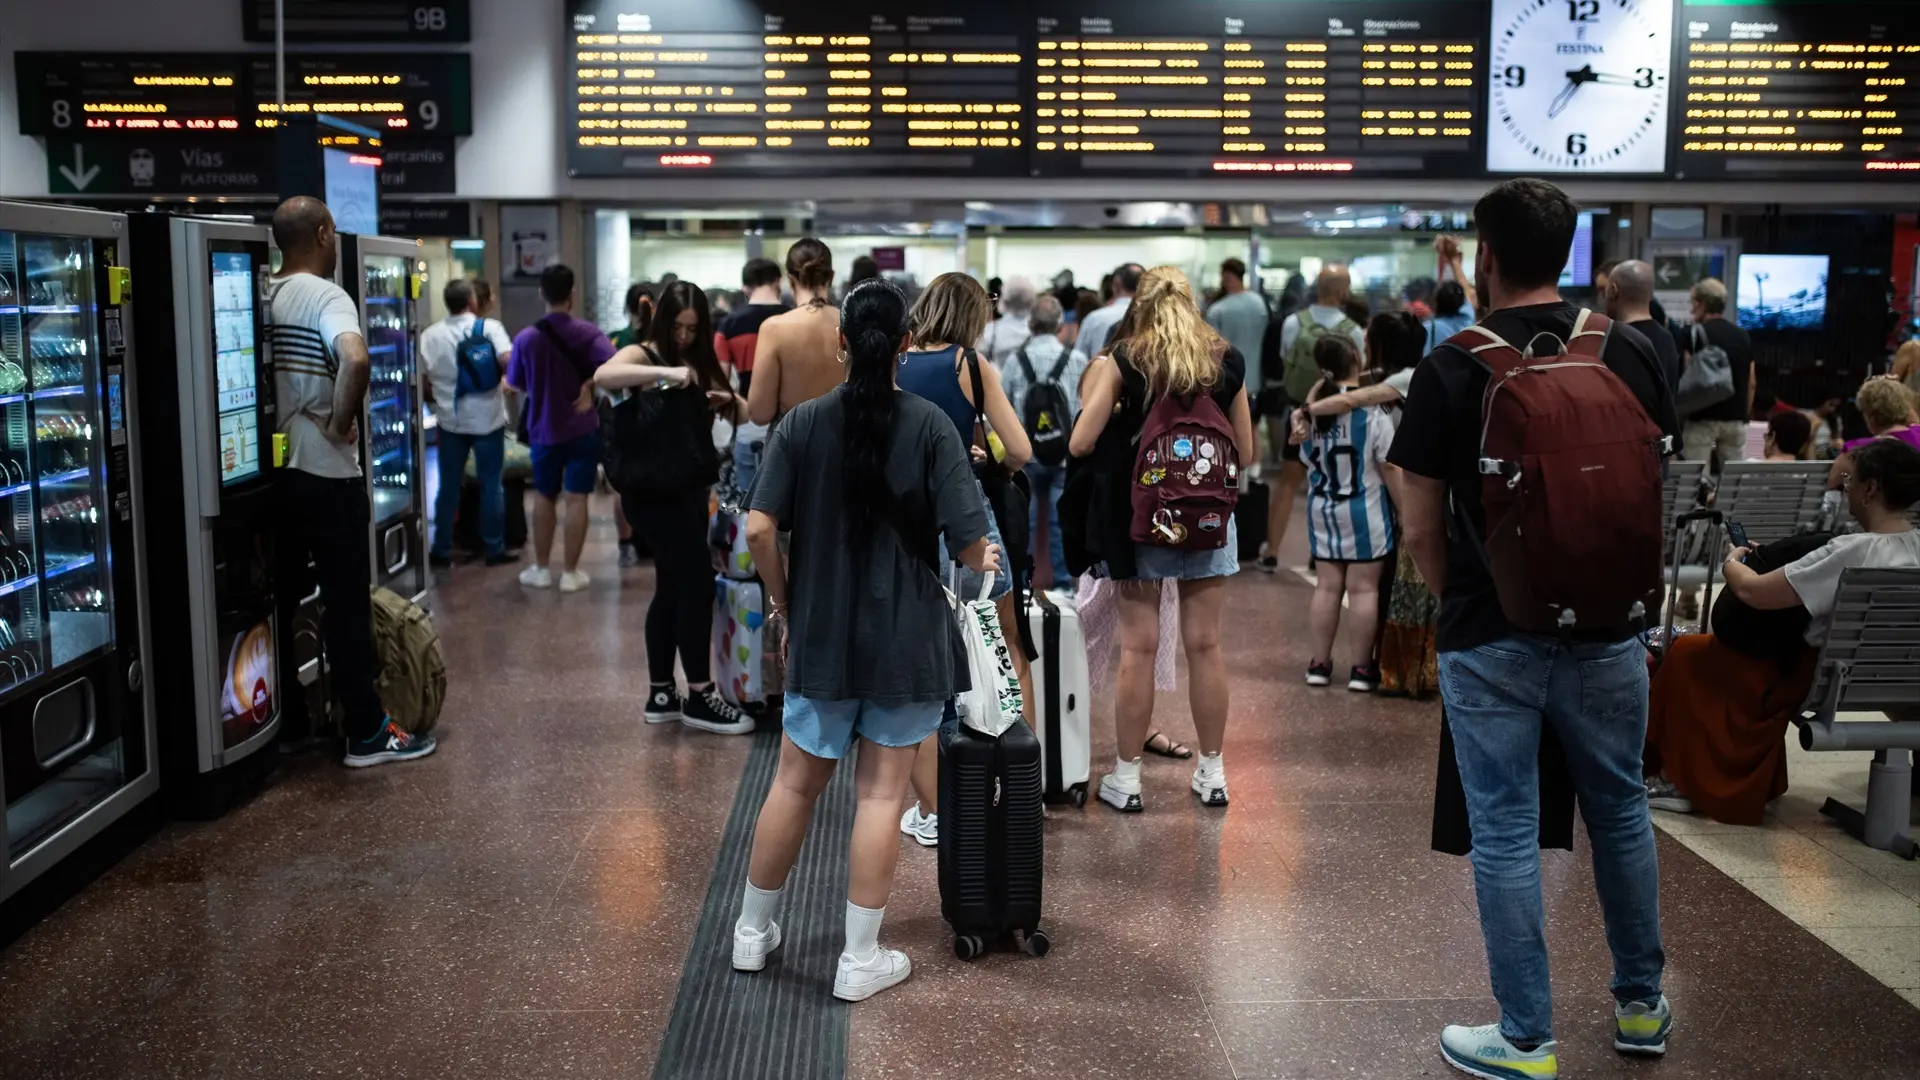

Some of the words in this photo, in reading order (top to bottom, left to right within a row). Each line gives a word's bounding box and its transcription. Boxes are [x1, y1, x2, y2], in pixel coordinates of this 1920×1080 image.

[413, 6, 446, 31] 9B
[1567, 0, 1600, 22] 12
[1555, 43, 1605, 55] FESTINA
[1504, 65, 1526, 88] 9
[1633, 67, 1654, 89] 3
[52, 99, 73, 130] 8
[418, 99, 440, 131] 9
[1566, 133, 1588, 155] 6
[180, 148, 225, 168] Vías
[384, 149, 445, 164] ercanías
[180, 173, 259, 186] PLATFORMS
[381, 168, 407, 185] tral
[1475, 1045, 1508, 1060] HOKA
